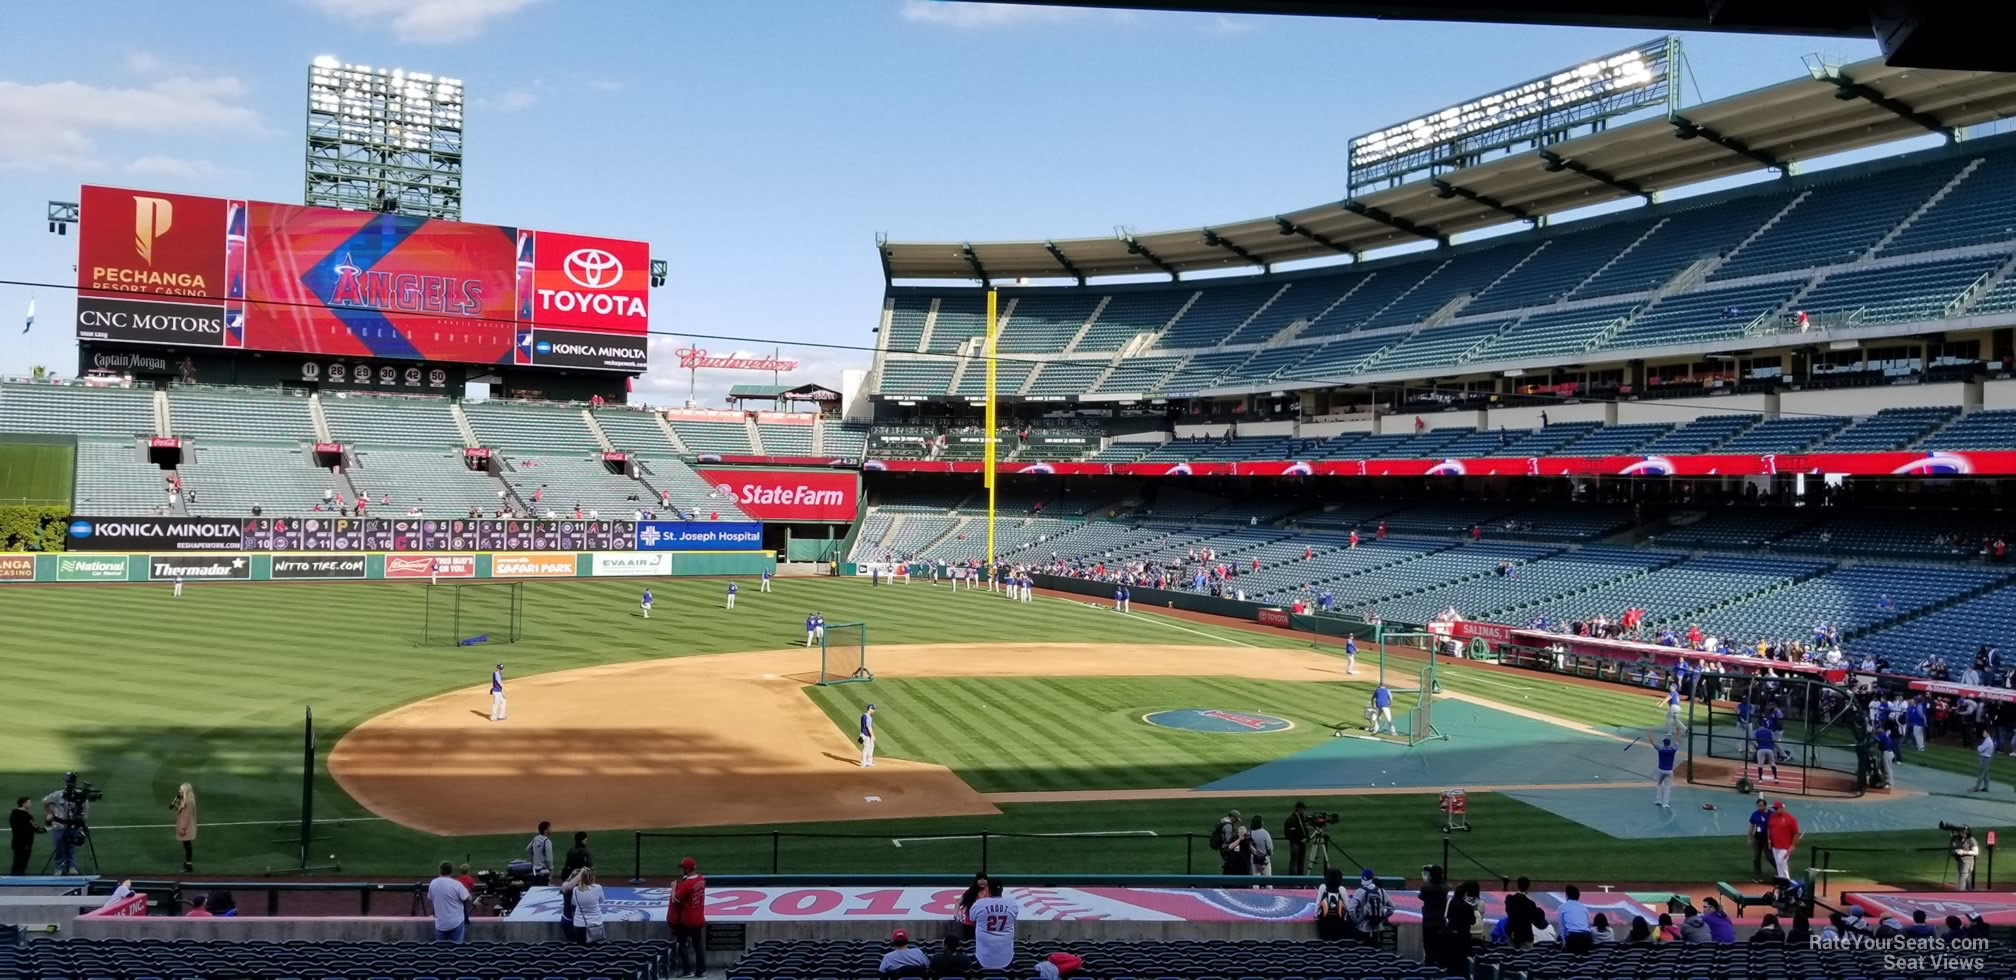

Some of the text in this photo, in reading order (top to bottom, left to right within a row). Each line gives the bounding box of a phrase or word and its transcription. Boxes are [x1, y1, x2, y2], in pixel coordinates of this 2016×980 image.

[93, 266, 206, 288] PECHANGA
[327, 253, 483, 316] ANGELS
[537, 288, 647, 318] TOYOTA
[79, 310, 221, 334] CNC MOTORS
[552, 343, 646, 360] KONICA MINOLTA
[94, 352, 166, 371] Captain Morgan
[305, 364, 315, 375] 11
[331, 365, 343, 376] 26
[356, 366, 369, 377] 29
[382, 368, 394, 379] 30
[407, 369, 419, 380] 42
[432, 371, 444, 381] 50
[95, 523, 164, 537] KONICA
[166, 523, 240, 537] MINOLTA
[261, 521, 268, 529] 3
[292, 521, 299, 529] 6
[323, 521, 328, 529] 1
[353, 521, 359, 529] 7
[382, 522, 388, 530] 1
[440, 522, 447, 530] 5
[468, 522, 475, 530] 5
[496, 522, 502, 530] 6
[602, 523, 608, 531] 8
[628, 523, 634, 531] 3
[662, 531, 760, 542] St. Joseph Hospital
[257, 539, 270, 548] 10
[292, 540, 297, 548] 1
[320, 540, 330, 548] 11
[351, 540, 359, 548] 4
[379, 540, 391, 548] 16
[411, 540, 417, 548] 6
[440, 540, 446, 548] 3
[523, 540, 529, 548] 5
[576, 540, 582, 548] 7
[602, 540, 608, 548] 3
[75, 560, 125, 571] National
[154, 563, 232, 577] Thermador
[275, 560, 364, 572] NITTO TIRE.COM
[496, 563, 573, 574] SAFARI PARK
[1267, 613, 1289, 623] TOYOTA
[1463, 624, 1502, 639] SALINAS,
[704, 889, 968, 916] 2018
[985, 904, 1009, 914] TROUT
[986, 915, 1008, 932] 27
